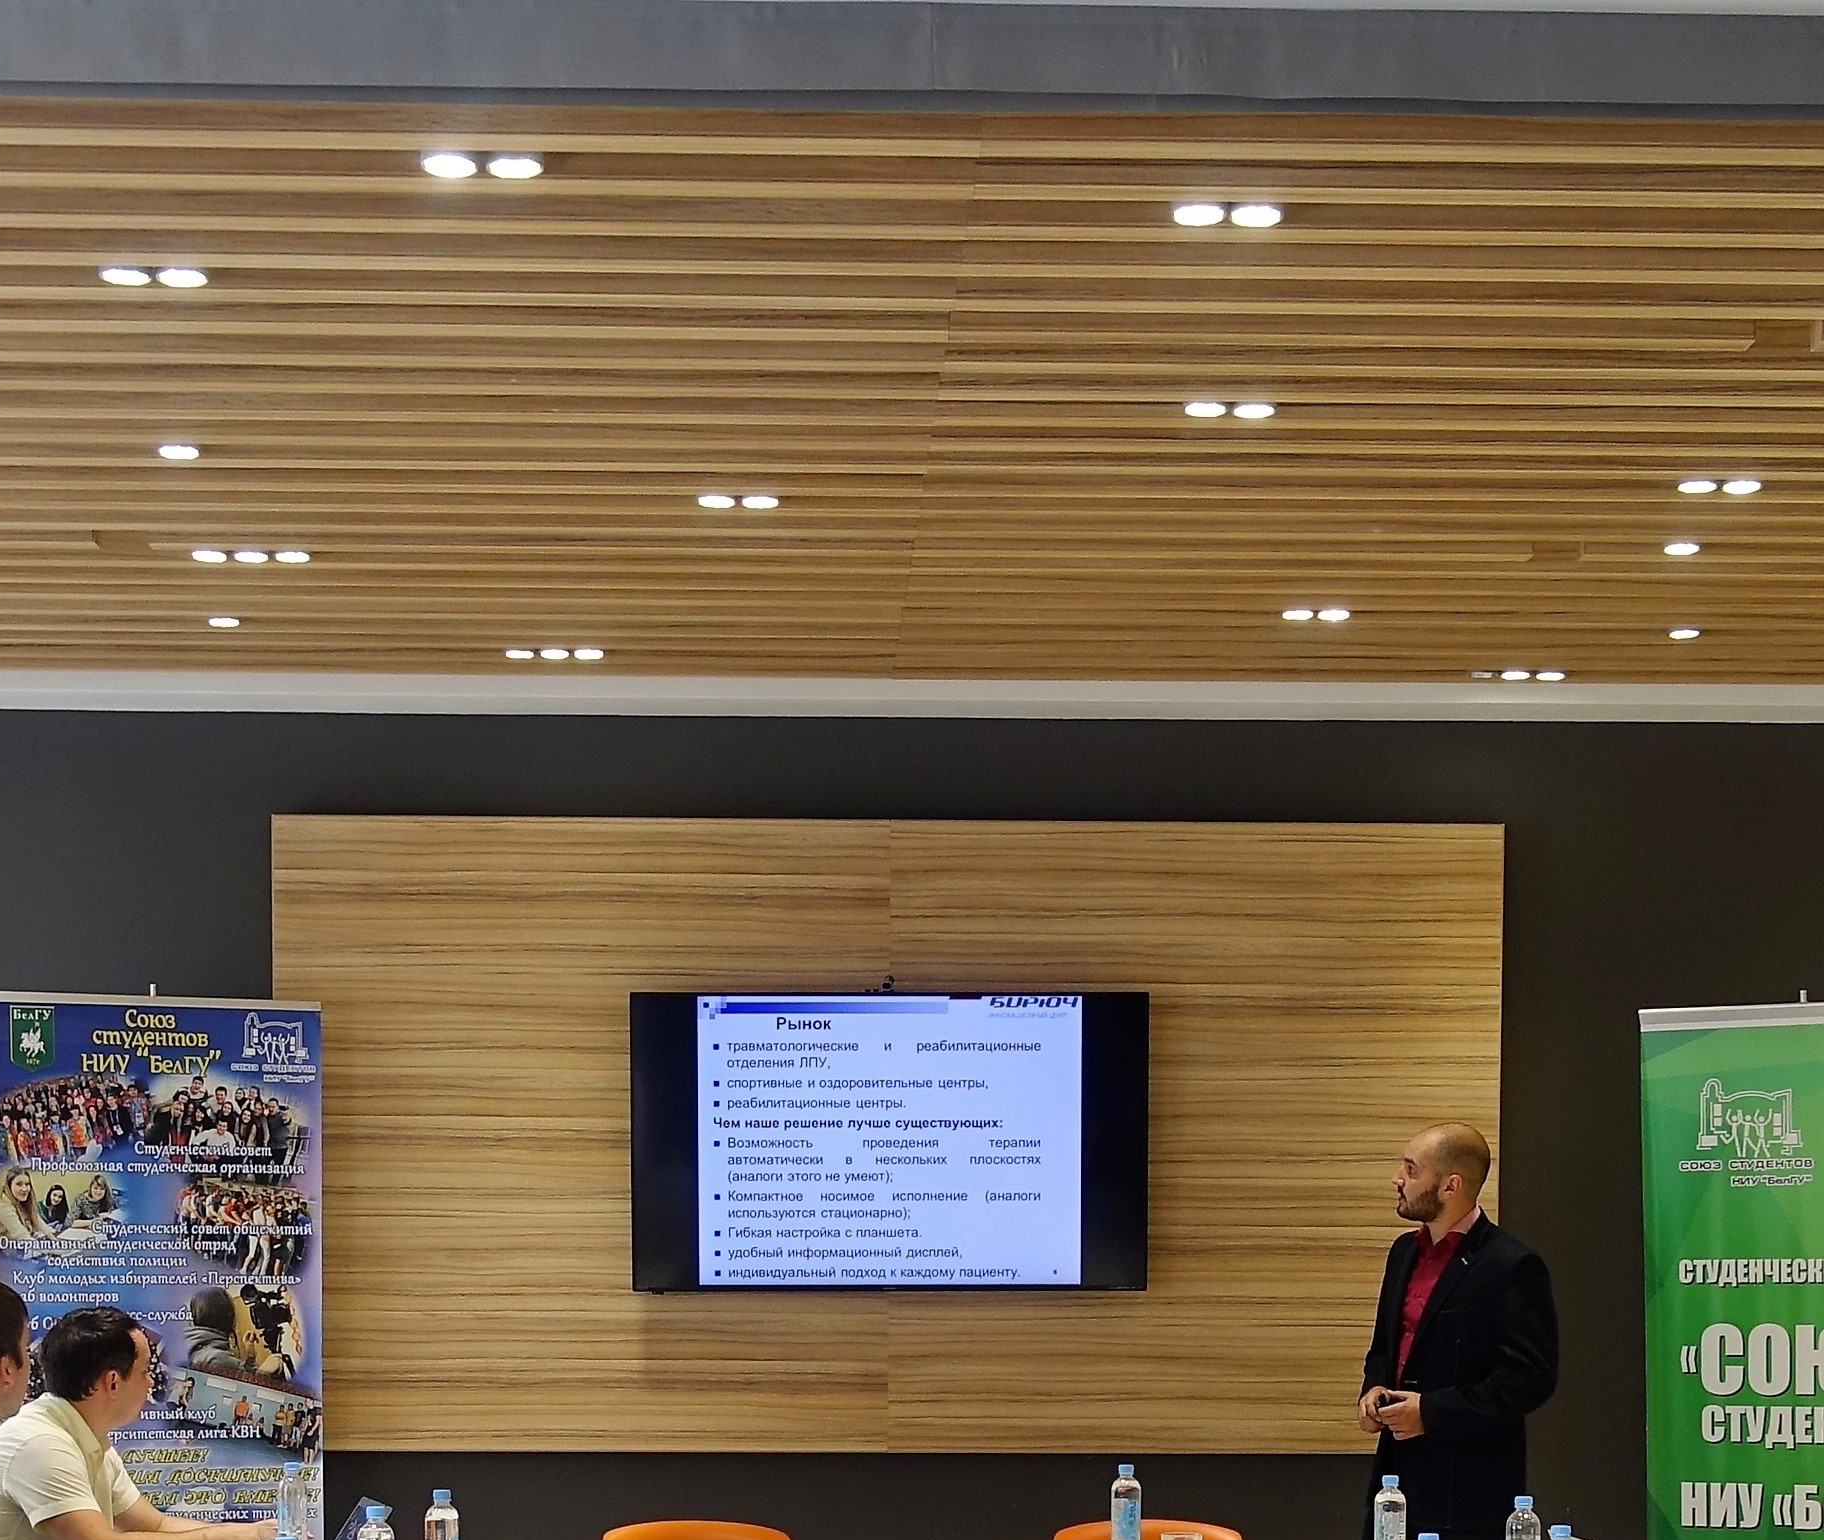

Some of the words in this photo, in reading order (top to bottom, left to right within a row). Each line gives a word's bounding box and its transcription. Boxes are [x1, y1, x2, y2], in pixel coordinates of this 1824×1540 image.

[13, 1009, 51, 1020] БелГУ
[124, 1008, 176, 1029] Союз
[776, 1016, 831, 1030] Рынок
[92, 1029, 209, 1049] студентов
[727, 1042, 859, 1054] травматологические
[884, 1043, 892, 1051] и
[917, 1039, 1041, 1054] реабилитационные
[80, 1053, 129, 1075] НИУ
[727, 1059, 794, 1069] отделения
[799, 1057, 831, 1069] ЛПУ,
[727, 1079, 803, 1090] спортивные
[808, 1079, 815, 1088] и
[819, 1079, 933, 1091] оздоровительные
[938, 1079, 989, 1090] центры,
[727, 1097, 851, 1111] реабилитационные
[856, 1099, 906, 1111] центры.
[713, 1117, 741, 1129] Чем
[745, 1120, 779, 1129] наше
[784, 1120, 843, 1131] решение
[848, 1120, 891, 1131] лучше
[895, 1119, 1003, 1131] существующих:
[134, 1141, 231, 1158] Студенческий
[234, 1145, 273, 1157] совет
[728, 1137, 813, 1148] Возможность
[863, 1139, 939, 1150] проведения
[989, 1139, 1041, 1150] терапии
[31, 1156, 123, 1176] Профсоюзная
[127, 1160, 217, 1176] студенческая
[220, 1161, 305, 1177] организация
[728, 1156, 823, 1165] автоматически
[845, 1156, 853, 1165] в
[876, 1156, 947, 1165] нескольких
[969, 1156, 1041, 1165] плоскостях
[1679, 1159, 1722, 1171] СОЮЗ
[1728, 1158, 1814, 1170] СТУДЕНТОВ
[727, 1170, 783, 1183] (аналоги
[787, 1173, 821, 1182] этого
[826, 1173, 840, 1182] не
[844, 1171, 893, 1184] умеют);
[1731, 1176, 1759, 1187] НИУ
[728, 1191, 803, 1201] Компактное
[820, 1192, 875, 1201] носимое
[892, 1192, 968, 1201] исполнение
[985, 1190, 1041, 1203] (аналоги
[728, 1209, 816, 1221] используются
[821, 1207, 911, 1221] стационарно);
[91, 1220, 188, 1237] Студенческий
[191, 1223, 231, 1236] совет
[233, 1220, 313, 1237] общежитий
[728, 1226, 772, 1238] Гибкая
[776, 1227, 840, 1240] настройка
[845, 1229, 853, 1238] с
[856, 1229, 922, 1238] планшета.
[99, 1237, 192, 1254] студенческой
[195, 1239, 236, 1255] отряд
[728, 1246, 783, 1260] удобный
[788, 1247, 901, 1260] информационный
[906, 1247, 962, 1258] дисплей,
[47, 1255, 126, 1269] содействия
[130, 1255, 187, 1268] полиции
[13, 1270, 45, 1287] Клуб
[48, 1273, 107, 1287] молодых
[110, 1272, 198, 1288] избирателей
[201, 1271, 302, 1288] «Перспектива»
[728, 1267, 836, 1280] индивидуальный
[841, 1268, 886, 1279] подход
[891, 1269, 897, 1277] к
[901, 1269, 955, 1280] каждому
[959, 1269, 1020, 1280] пациенту.
[39, 1292, 120, 1306] волонтеров
[140, 1405, 184, 1420] ивный
[186, 1403, 216, 1424] клуб
[197, 1427, 228, 1441] лига
[230, 1422, 261, 1439] КВН
[184, 1488, 226, 1505] ЭТО
[1680, 1482, 1763, 1529] НИУ
